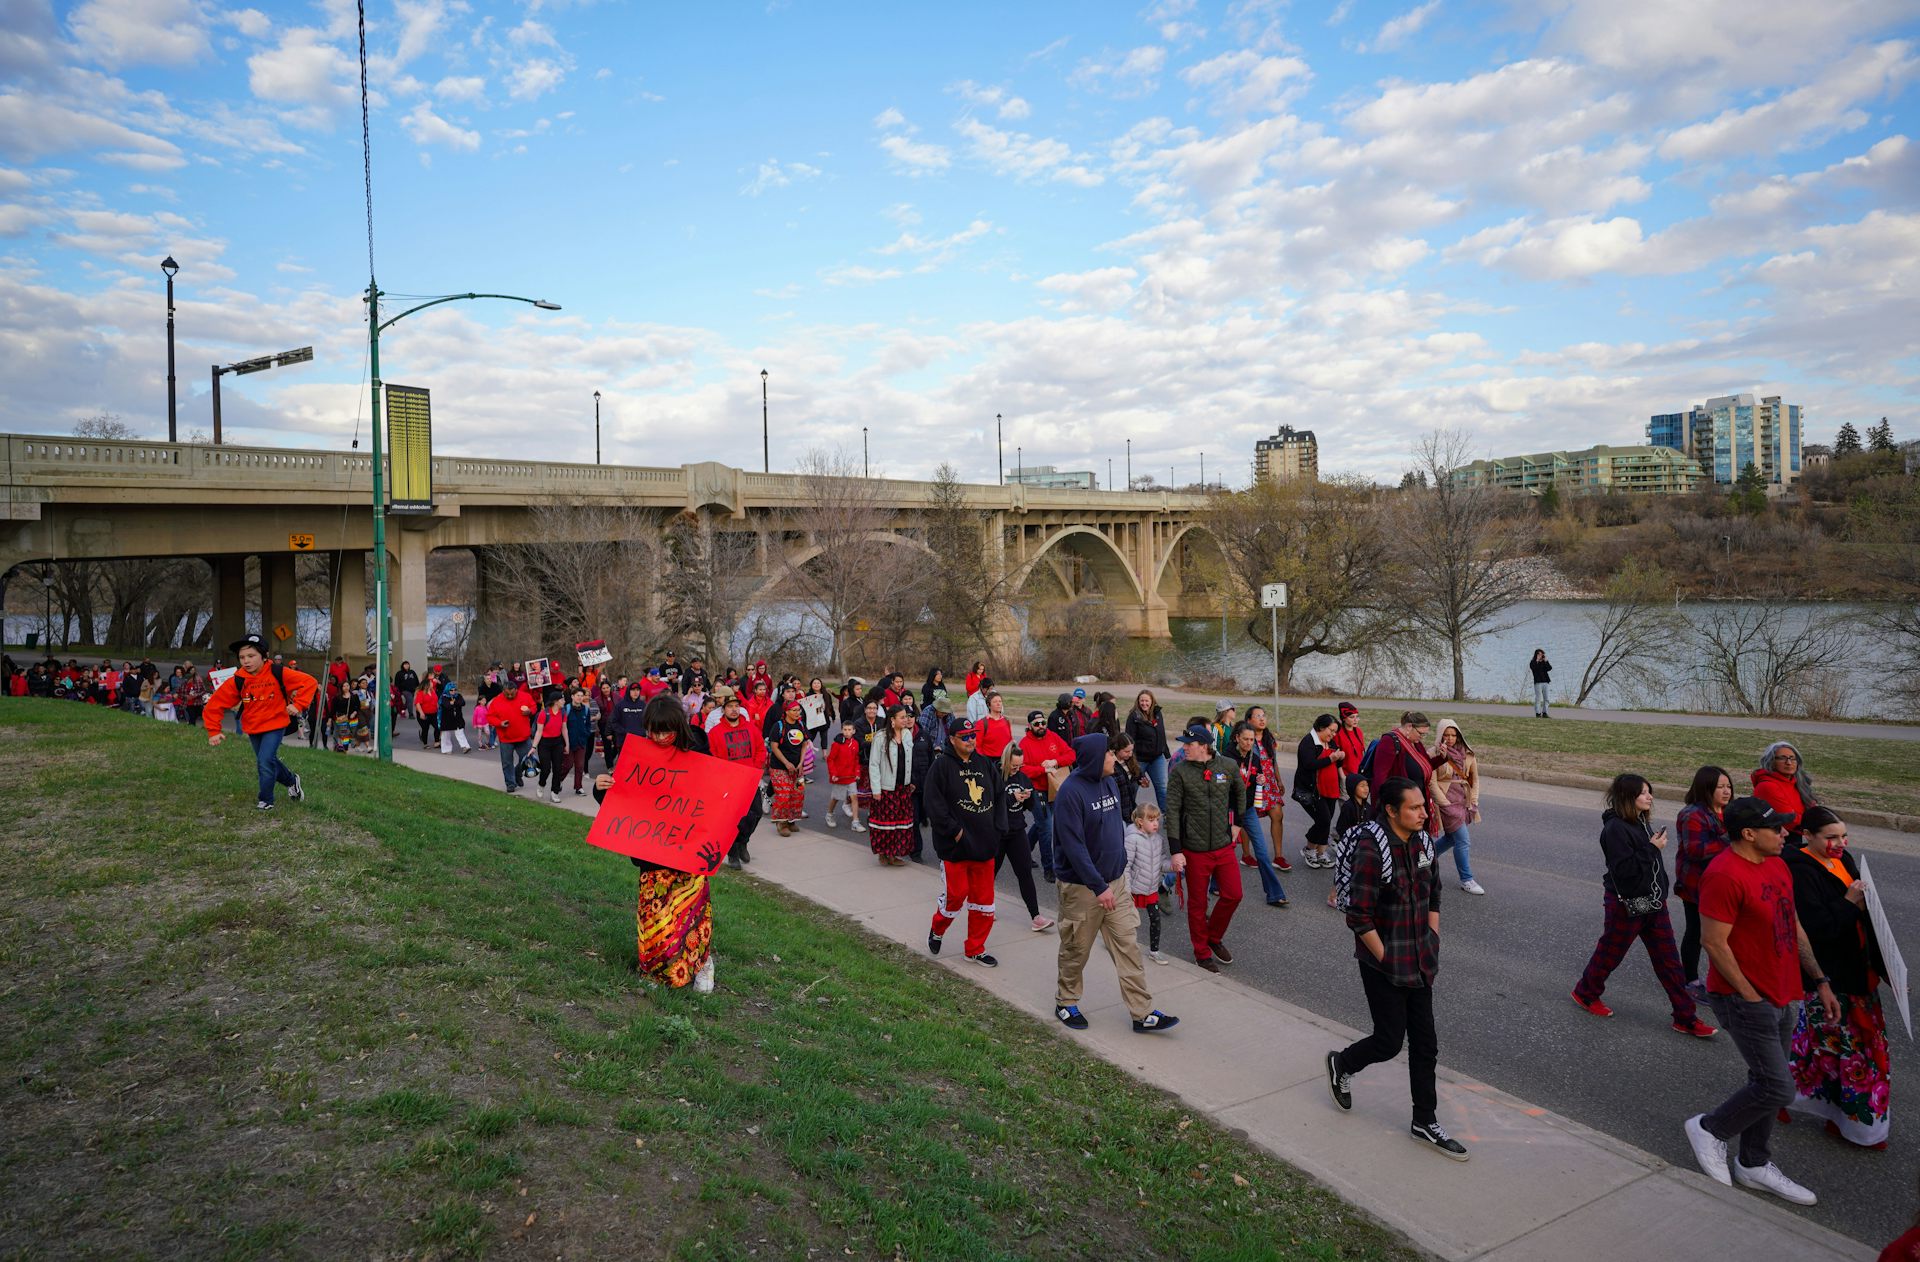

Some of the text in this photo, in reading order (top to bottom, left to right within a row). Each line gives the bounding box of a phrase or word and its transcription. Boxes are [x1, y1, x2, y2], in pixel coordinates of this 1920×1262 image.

[625, 763, 689, 789] NOT
[655, 794, 705, 817] ONE
[606, 815, 696, 851] MORE!
